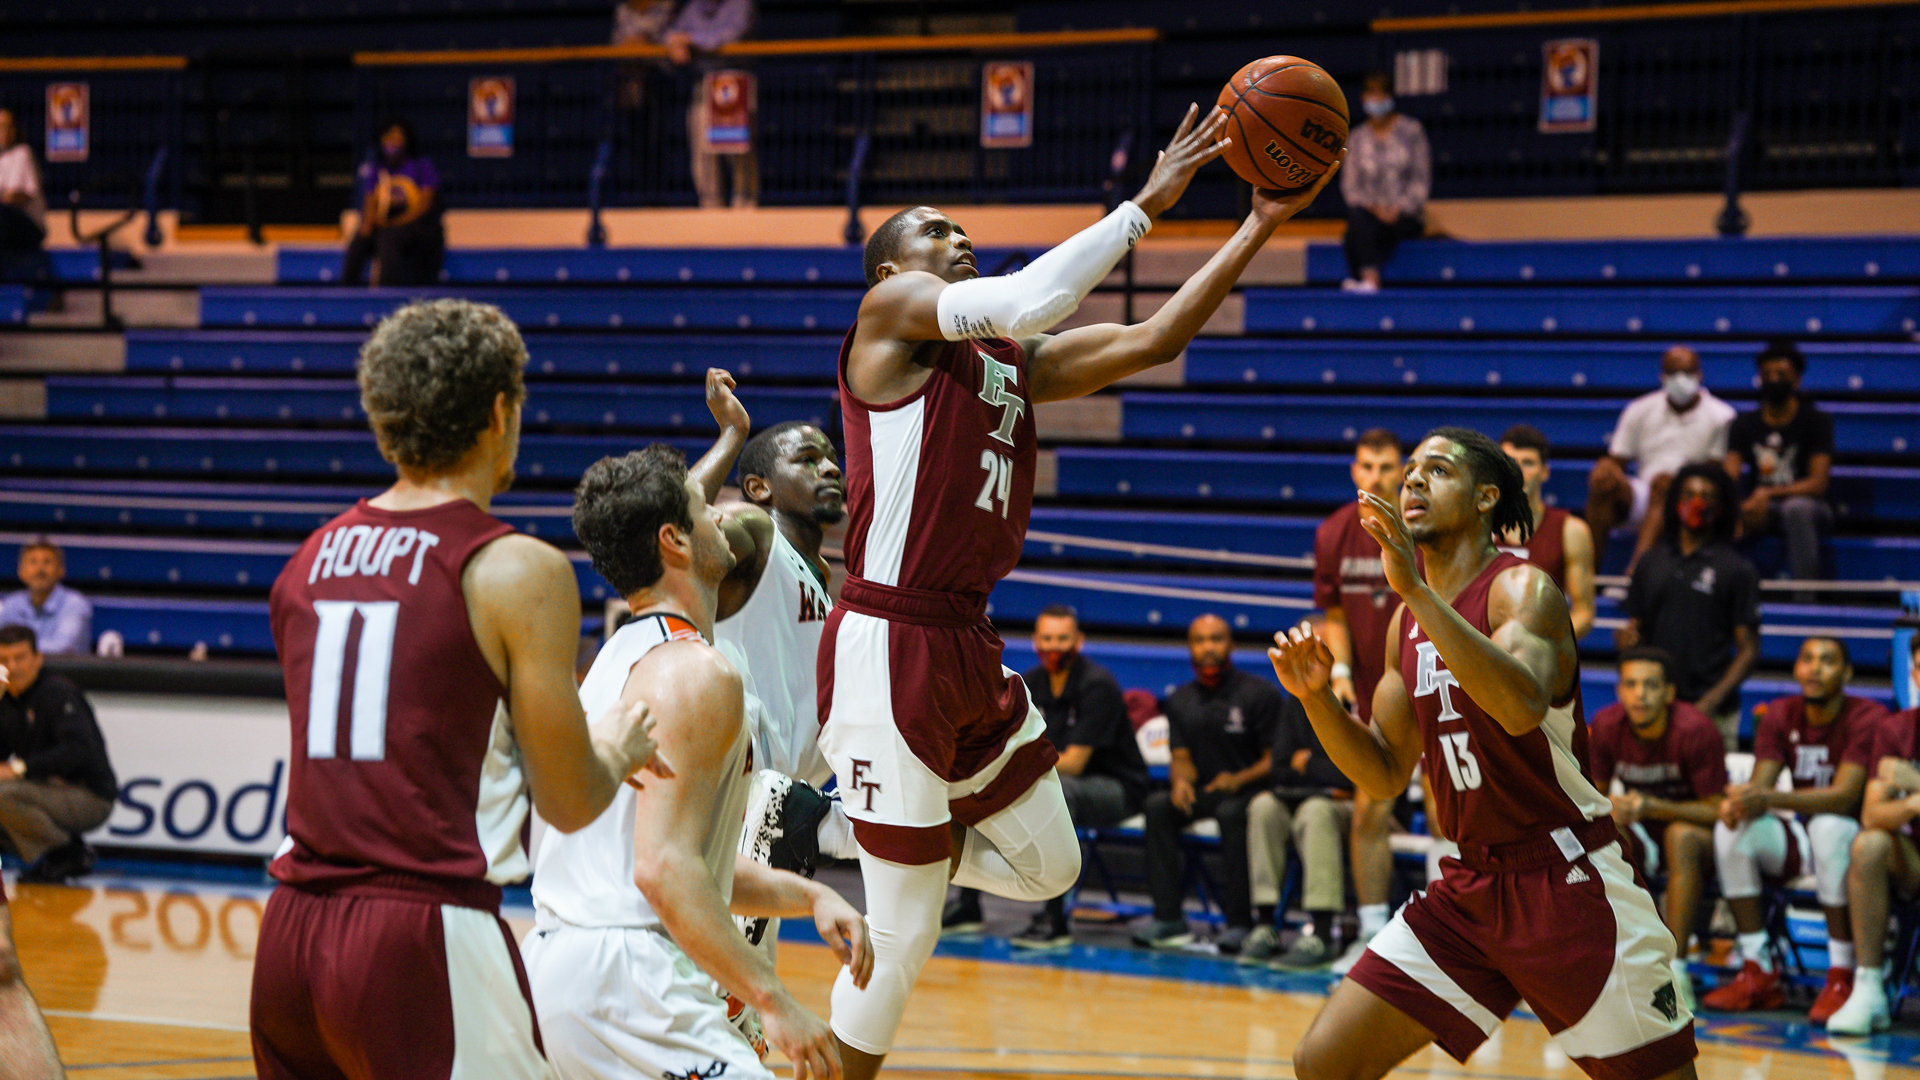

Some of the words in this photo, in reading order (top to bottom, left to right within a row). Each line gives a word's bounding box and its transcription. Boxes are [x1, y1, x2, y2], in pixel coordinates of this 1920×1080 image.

[978, 350, 1026, 448] FT
[975, 449, 1014, 520] 24
[308, 525, 440, 586] HOUPT
[307, 600, 400, 761] 11
[849, 756, 882, 813] FT
[1438, 730, 1482, 792] 13
[109, 759, 288, 844] sod
